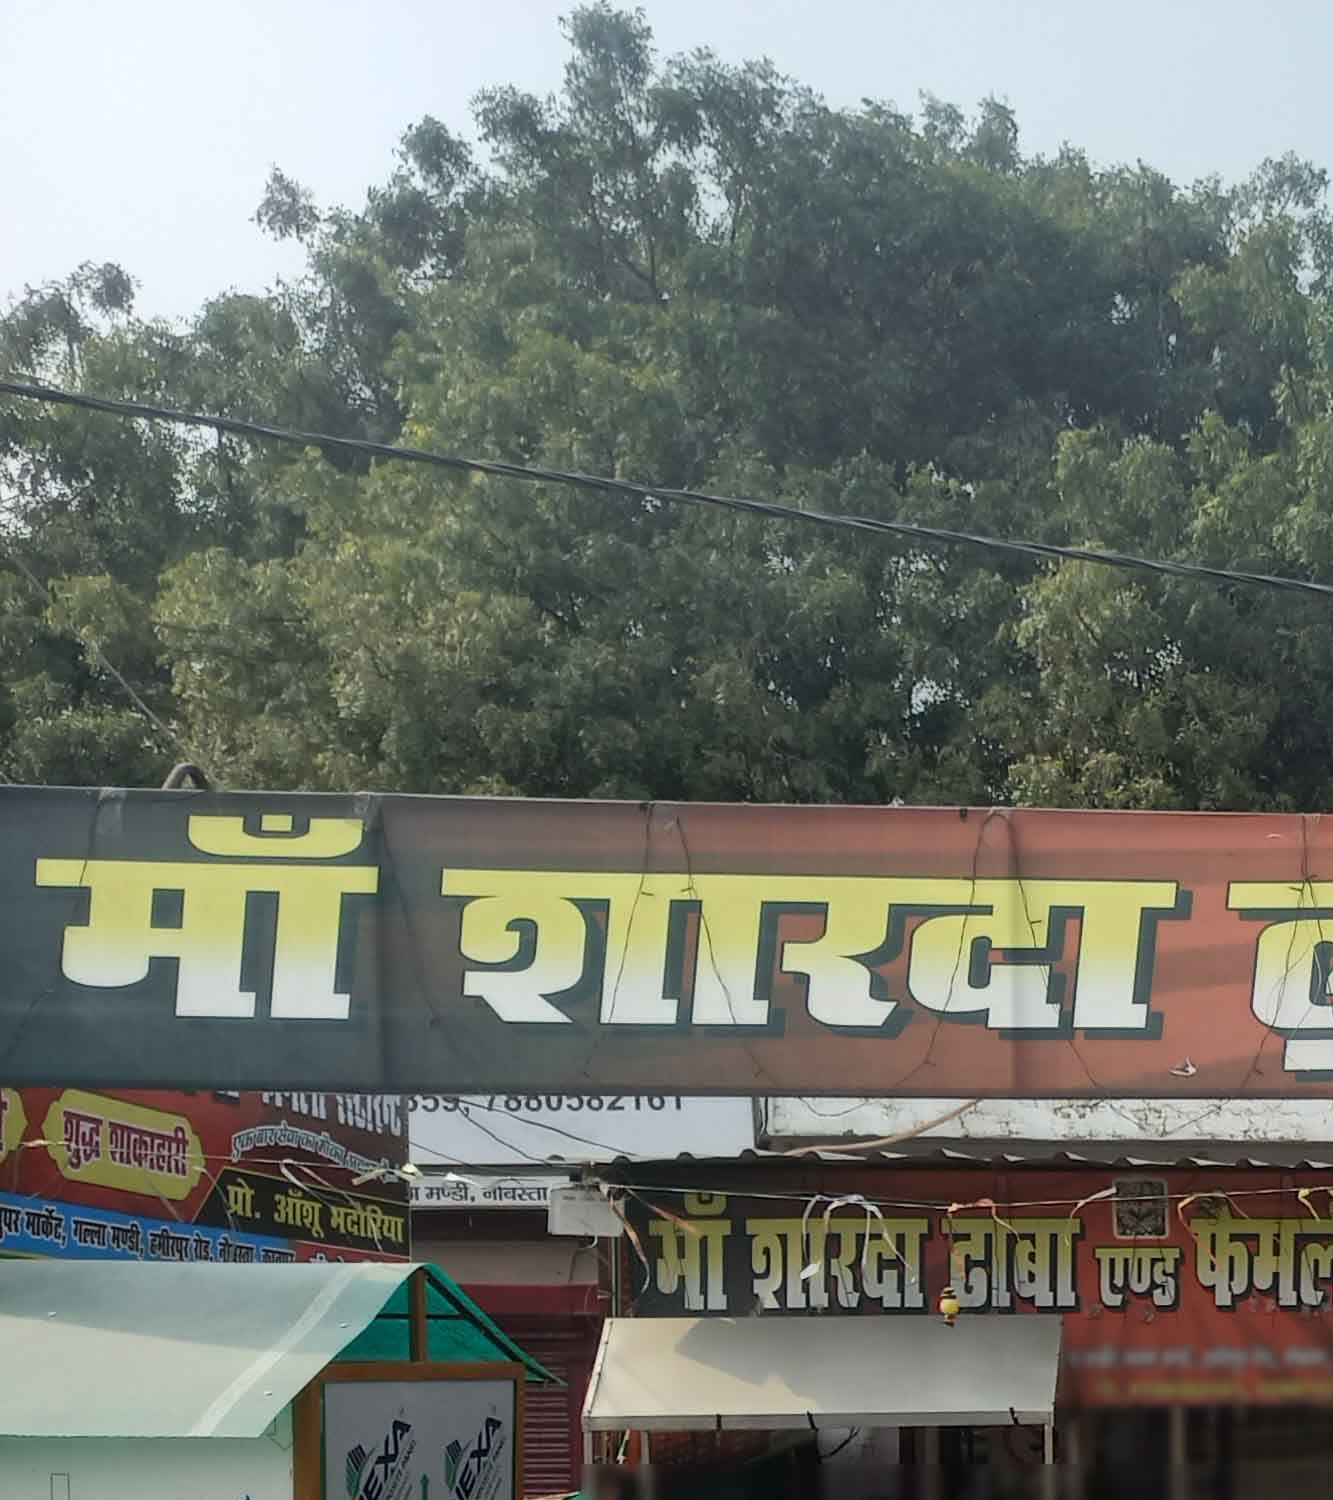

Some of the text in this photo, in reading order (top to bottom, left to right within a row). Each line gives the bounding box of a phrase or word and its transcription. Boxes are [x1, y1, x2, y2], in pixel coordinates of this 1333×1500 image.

[35, 814, 380, 1019] माँ
[440, 867, 1178, 1031] शारदा
[63, 1110, 103, 1170] शुद्ध
[108, 1119, 189, 1177] शाकाहारी
[226, 1178, 261, 1220] प्रो.
[72, 1218, 107, 1248] गल्ला
[109, 1221, 144, 1257] मण्डी,
[746, 1218, 929, 1310] शारदा
[1096, 1248, 1182, 1306] एण्ड
